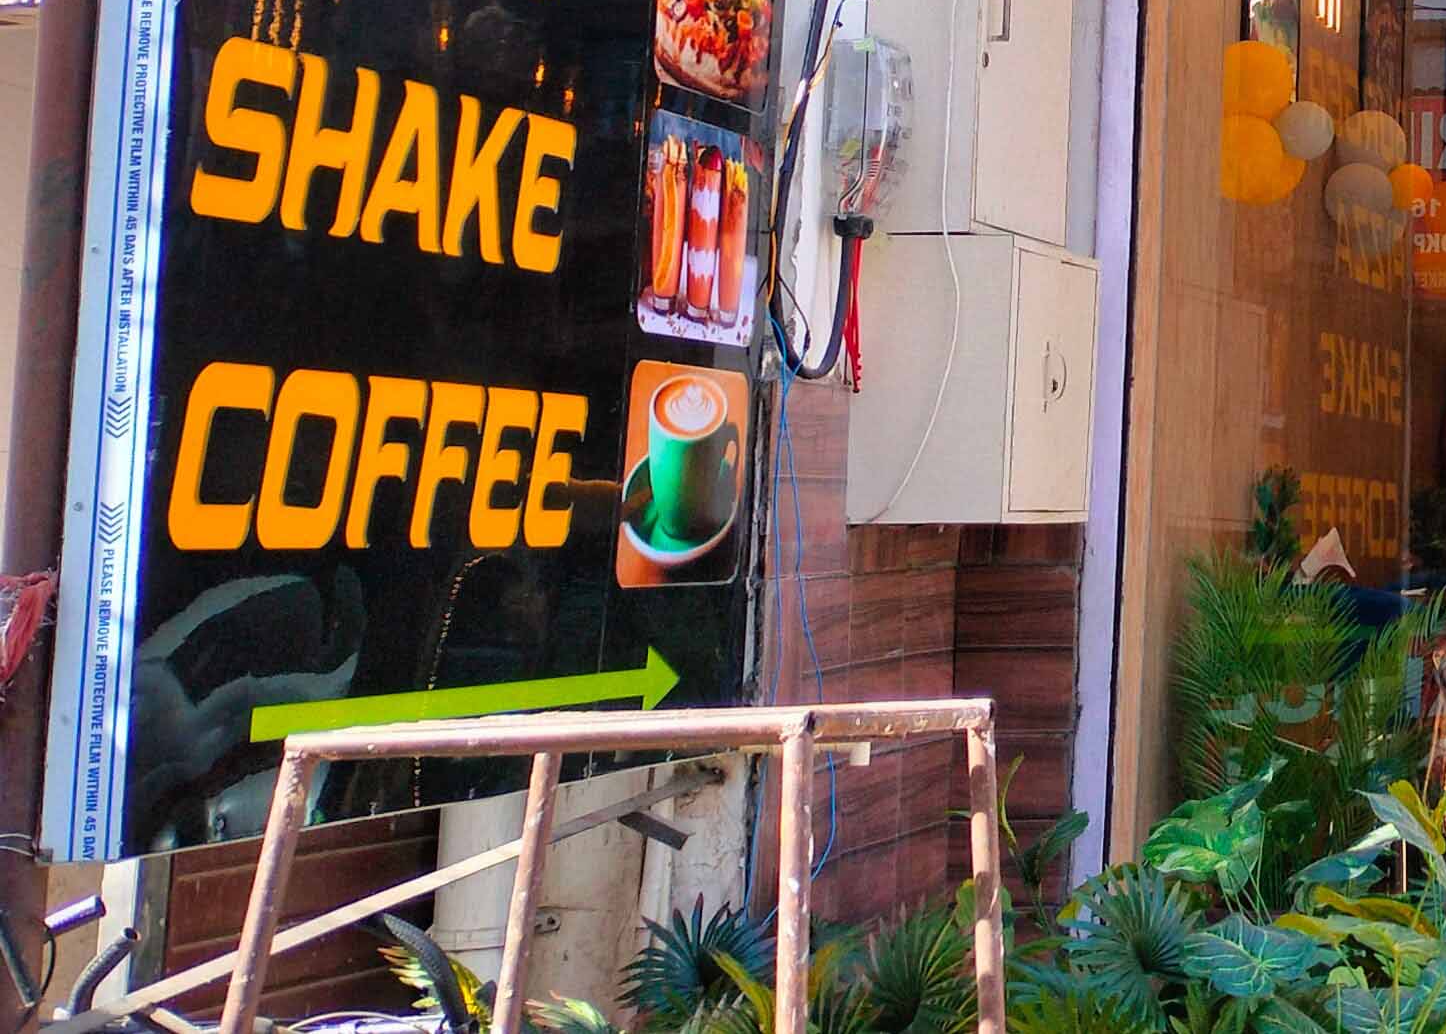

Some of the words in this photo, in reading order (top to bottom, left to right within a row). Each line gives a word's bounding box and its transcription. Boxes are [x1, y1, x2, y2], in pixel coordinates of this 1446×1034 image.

[137, 12, 152, 60] REMOVE
[131, 64, 149, 134] PROTECTIVE
[129, 138, 143, 166] FILM
[191, 35, 577, 273] SHAKE
[126, 170, 142, 212] WITHIN
[126, 215, 138, 230] 45
[123, 234, 137, 265] DAYS
[120, 268, 134, 305] AFTER
[114, 309, 131, 393] INSTALLATION
[168, 361, 589, 550] COFFEE
[100, 548, 115, 595] PLEASE
[96, 599, 111, 652] REMOVE
[91, 655, 108, 730] PROTECTIVE
[88, 733, 102, 764] FILM
[85, 767, 100, 812] WITHIN
[84, 816, 97, 832] 45
